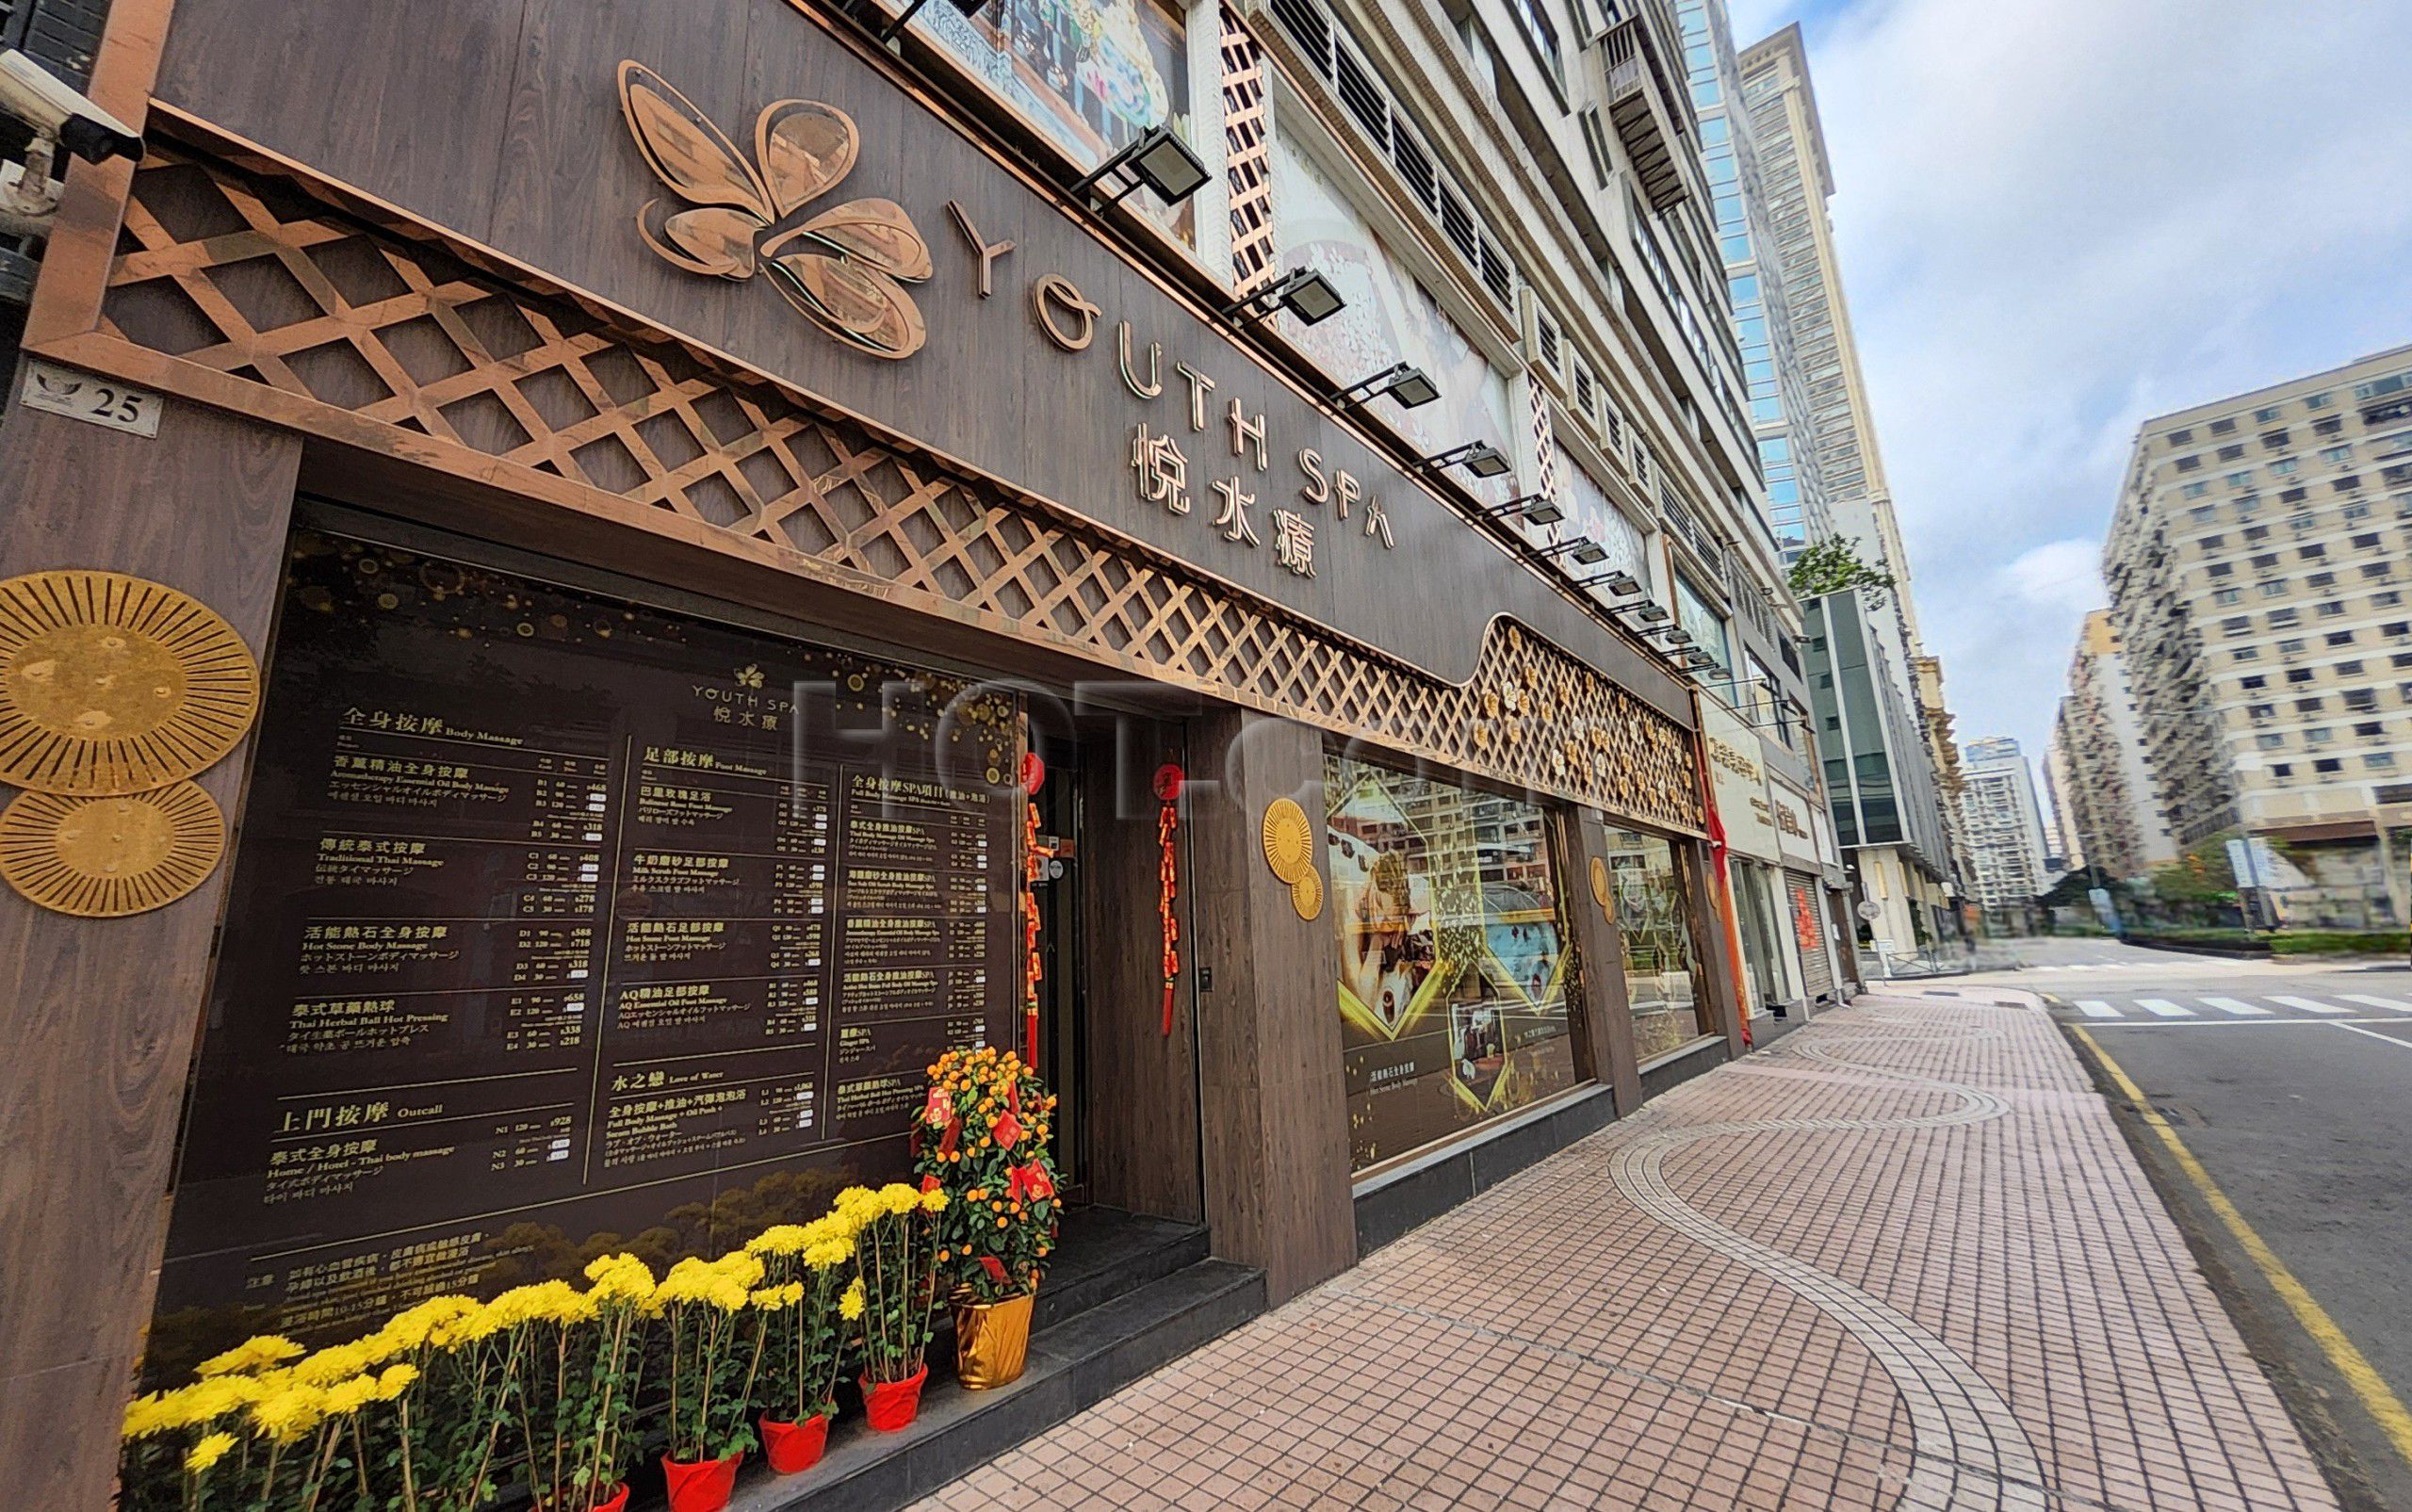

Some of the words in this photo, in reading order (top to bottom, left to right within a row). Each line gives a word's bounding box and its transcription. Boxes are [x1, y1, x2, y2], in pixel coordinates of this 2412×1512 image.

[947, 199, 1267, 471] YOUTH
[1298, 447, 1394, 549] SPA
[91, 388, 143, 423] 25
[1132, 421, 1318, 578] 悅水療
[693, 686, 758, 707] YOUTH
[768, 699, 799, 715] SPA
[340, 707, 443, 735] 全身按摩
[446, 727, 474, 740] Body
[477, 731, 523, 745] Massage
[644, 746, 714, 768] 足部按摩
[715, 761, 733, 770] Foot
[734, 764, 767, 775] Massage
[437, 779, 450, 788] Oil
[851, 789, 864, 797] Full
[865, 790, 881, 800] Body
[317, 853, 374, 864] Traditional
[377, 855, 399, 864] Thai
[402, 857, 445, 868] Massage
[302, 942, 323, 951] Hot
[326, 942, 355, 951] Stone
[358, 941, 383, 951] Body
[386, 941, 428, 951] Massage
[289, 1019, 316, 1030] Thai
[319, 1018, 357, 1027] Herbal
[360, 1016, 382, 1025] Ball
[669, 1076, 688, 1084] Love
[690, 1073, 699, 1081] of
[701, 1071, 724, 1080] Water
[271, 1101, 390, 1134] 上門按摩
[397, 1104, 444, 1118] Outcall
[607, 1120, 623, 1129] Full
[625, 1117, 644, 1126] Body
[267, 1167, 304, 1179] Home
[318, 1160, 349, 1172] Hotel
[359, 1156, 383, 1166] Thai
[385, 1152, 411, 1162] body
[412, 1146, 455, 1158] massage
